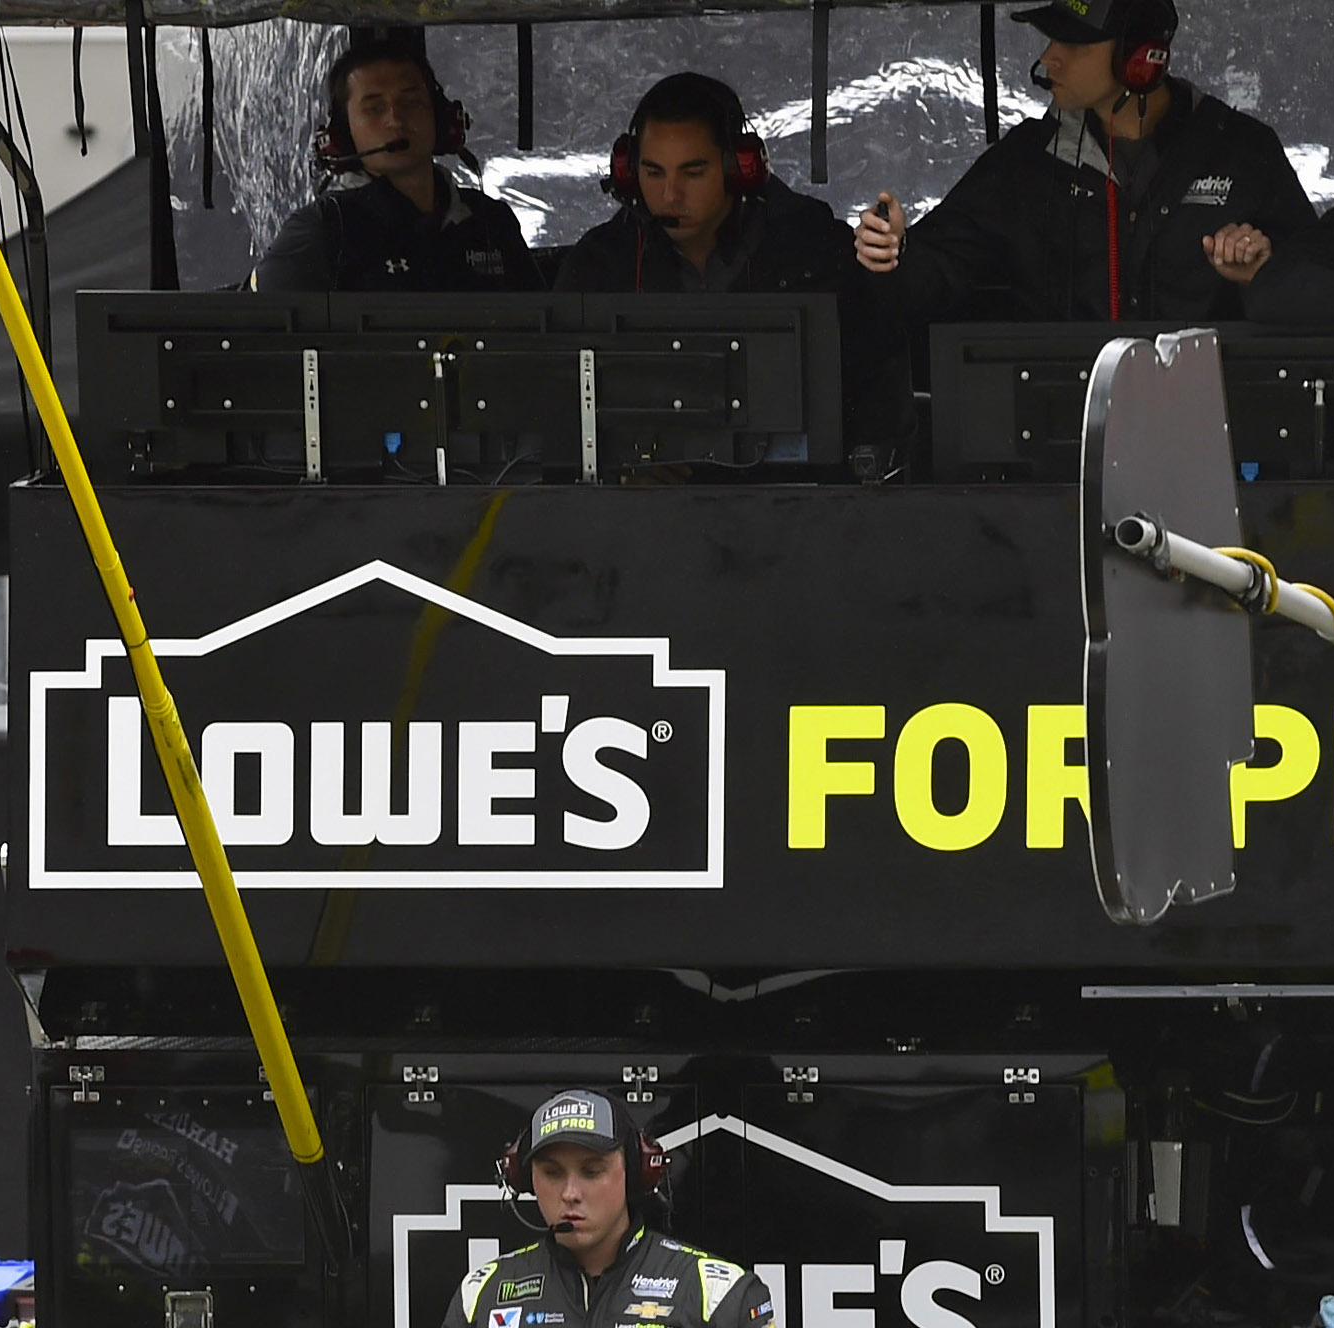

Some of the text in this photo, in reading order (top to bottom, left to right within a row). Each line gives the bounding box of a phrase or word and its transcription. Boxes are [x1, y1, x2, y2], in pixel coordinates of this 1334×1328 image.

[107, 694, 651, 851] LOWE'S
[545, 1100, 588, 1120] LOWE'S
[540, 1118, 596, 1136] FOR PROS
